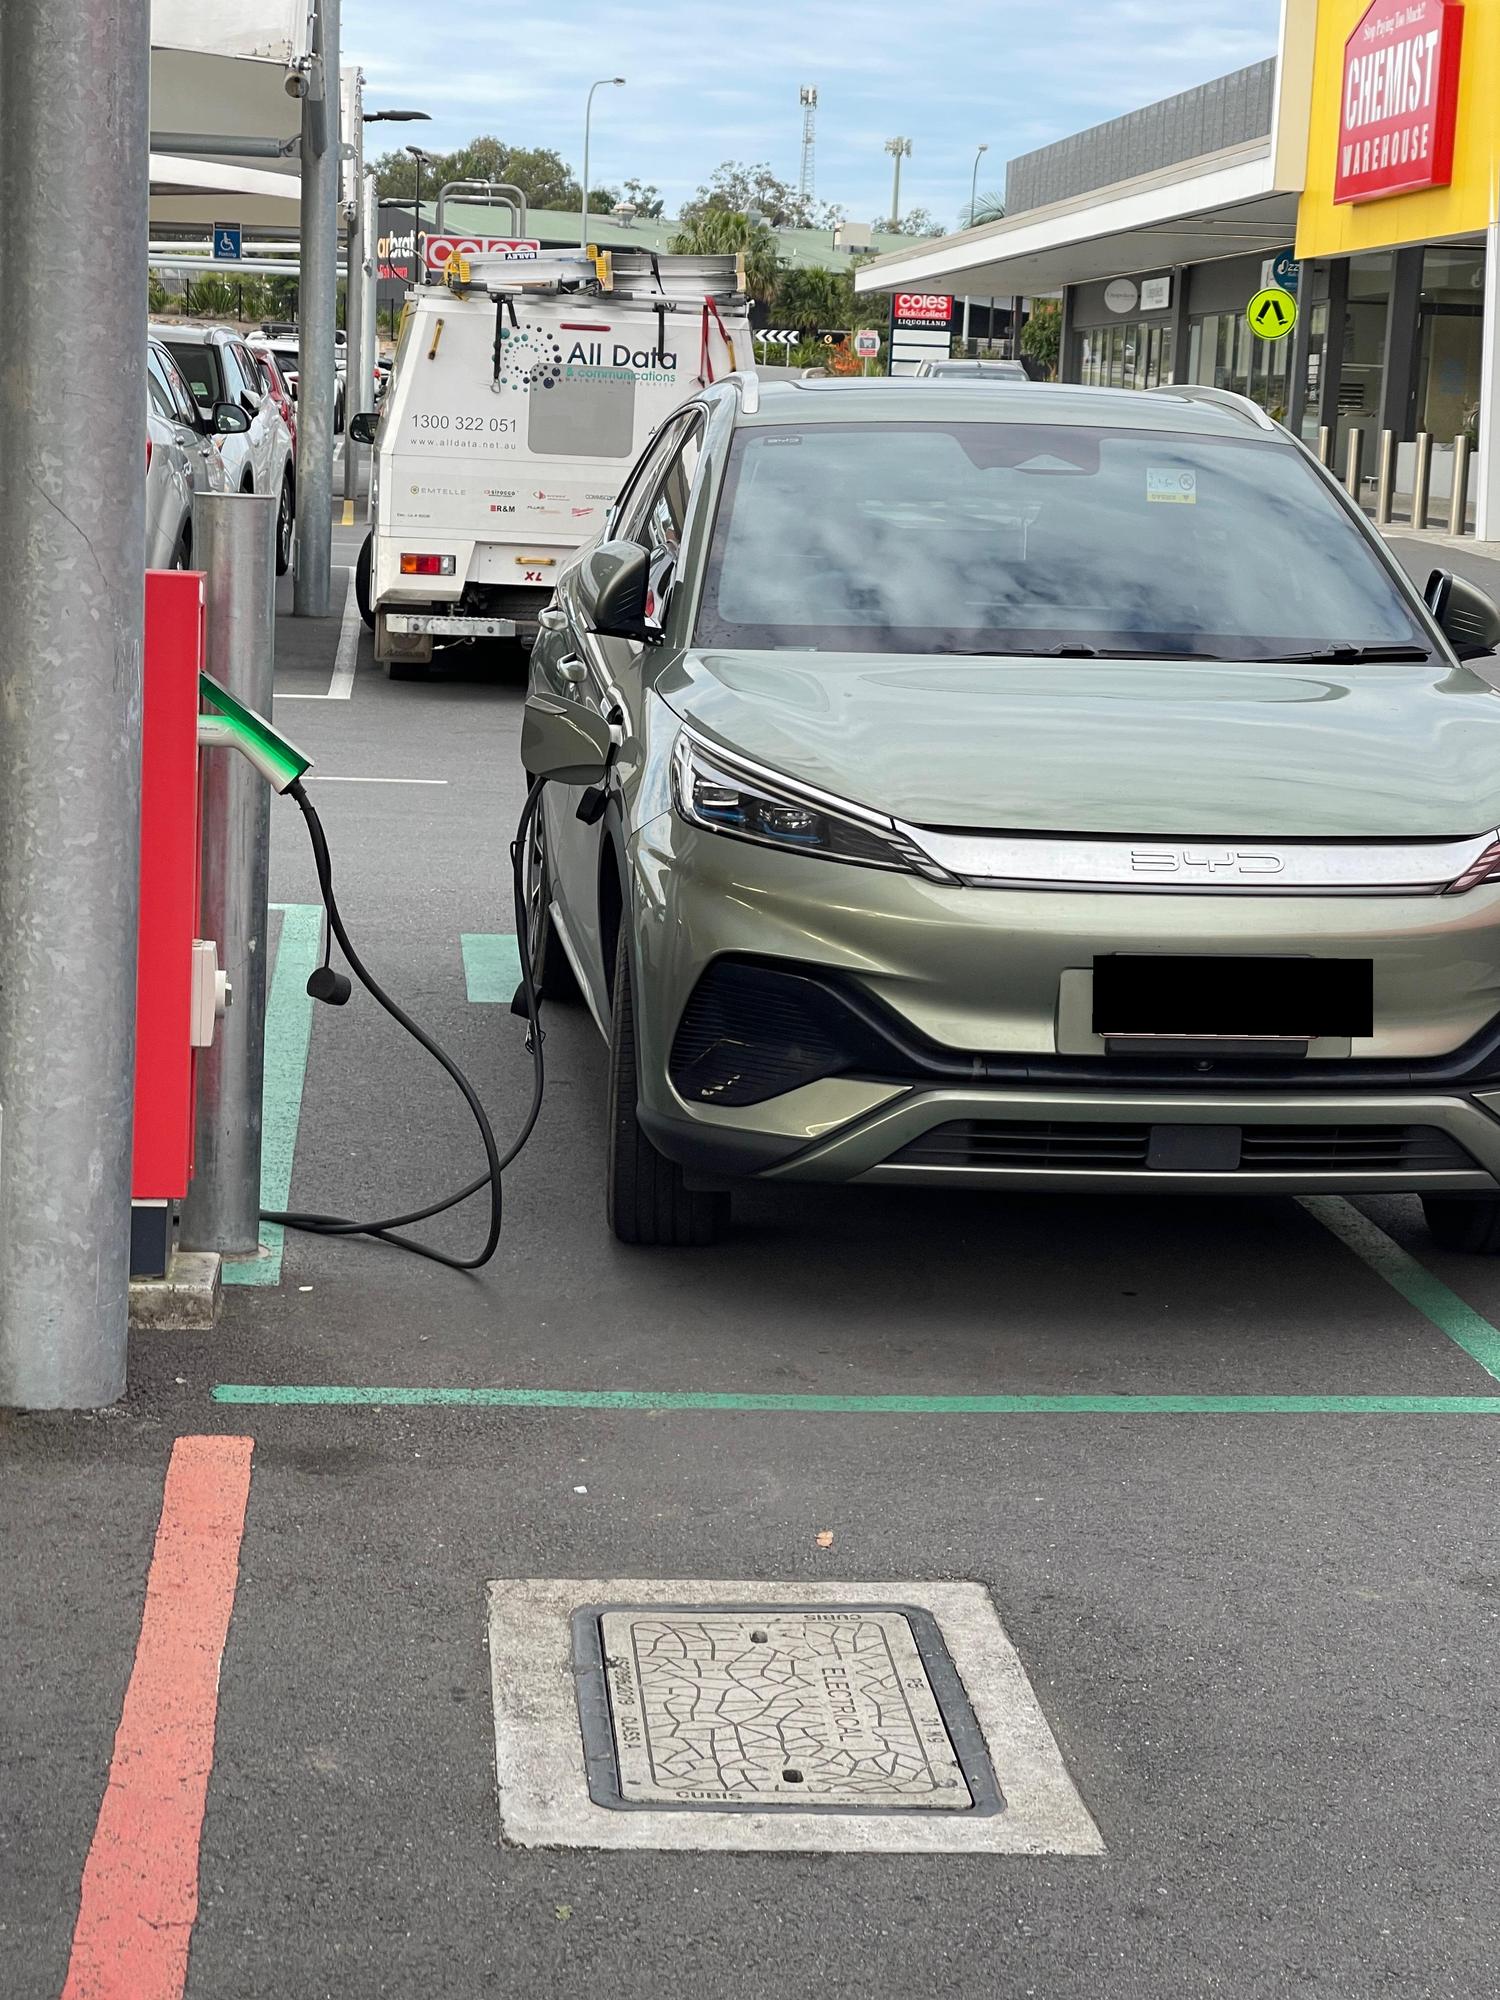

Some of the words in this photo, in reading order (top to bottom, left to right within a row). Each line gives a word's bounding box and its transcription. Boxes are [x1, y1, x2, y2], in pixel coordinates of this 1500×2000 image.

[1345, 29, 1438, 131] CHEMIST
[1342, 123, 1429, 178] WAREHOUSE
[506, 252, 536, 260] BAILEY
[899, 294, 948, 309] coles
[567, 341, 602, 365] All
[613, 344, 677, 370] Data
[578, 370, 675, 382] communications
[411, 414, 449, 429] 1300
[455, 417, 484, 431] 322
[489, 418, 516, 432] 051
[410, 439, 516, 450] www.alldata.net.au
[421, 487, 466, 495] EMTELLE
[524, 571, 542, 581] XL
[1131, 850, 1285, 873] BYD
[821, 1667, 863, 1742] ELECTRICAL
[620, 1716, 641, 1742] CLASS
[676, 1791, 742, 1799] CUBIS
